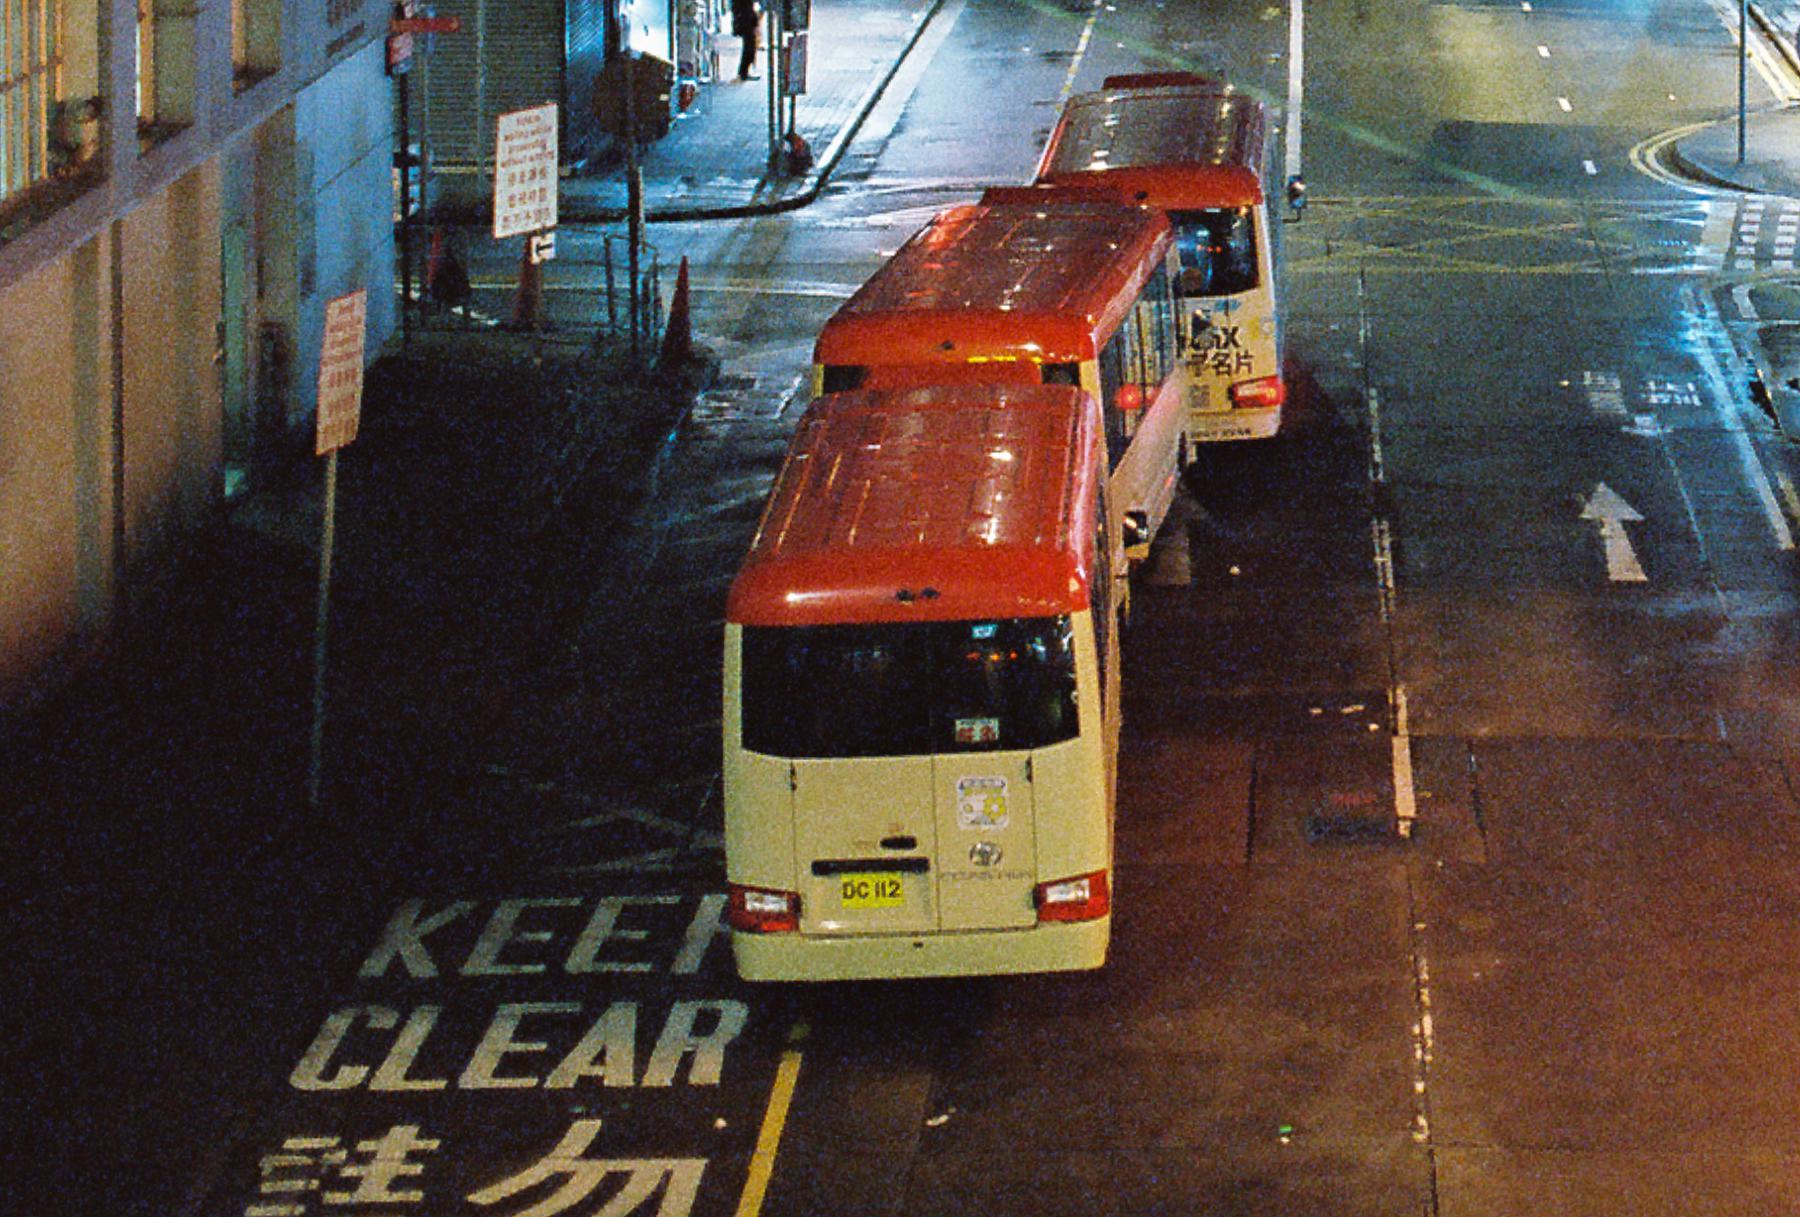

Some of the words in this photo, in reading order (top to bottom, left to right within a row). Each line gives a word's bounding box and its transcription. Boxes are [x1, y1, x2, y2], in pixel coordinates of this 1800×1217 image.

[842, 882, 870, 901] DC
[874, 880, 902, 899] 112
[289, 999, 750, 1092] CLEAR
